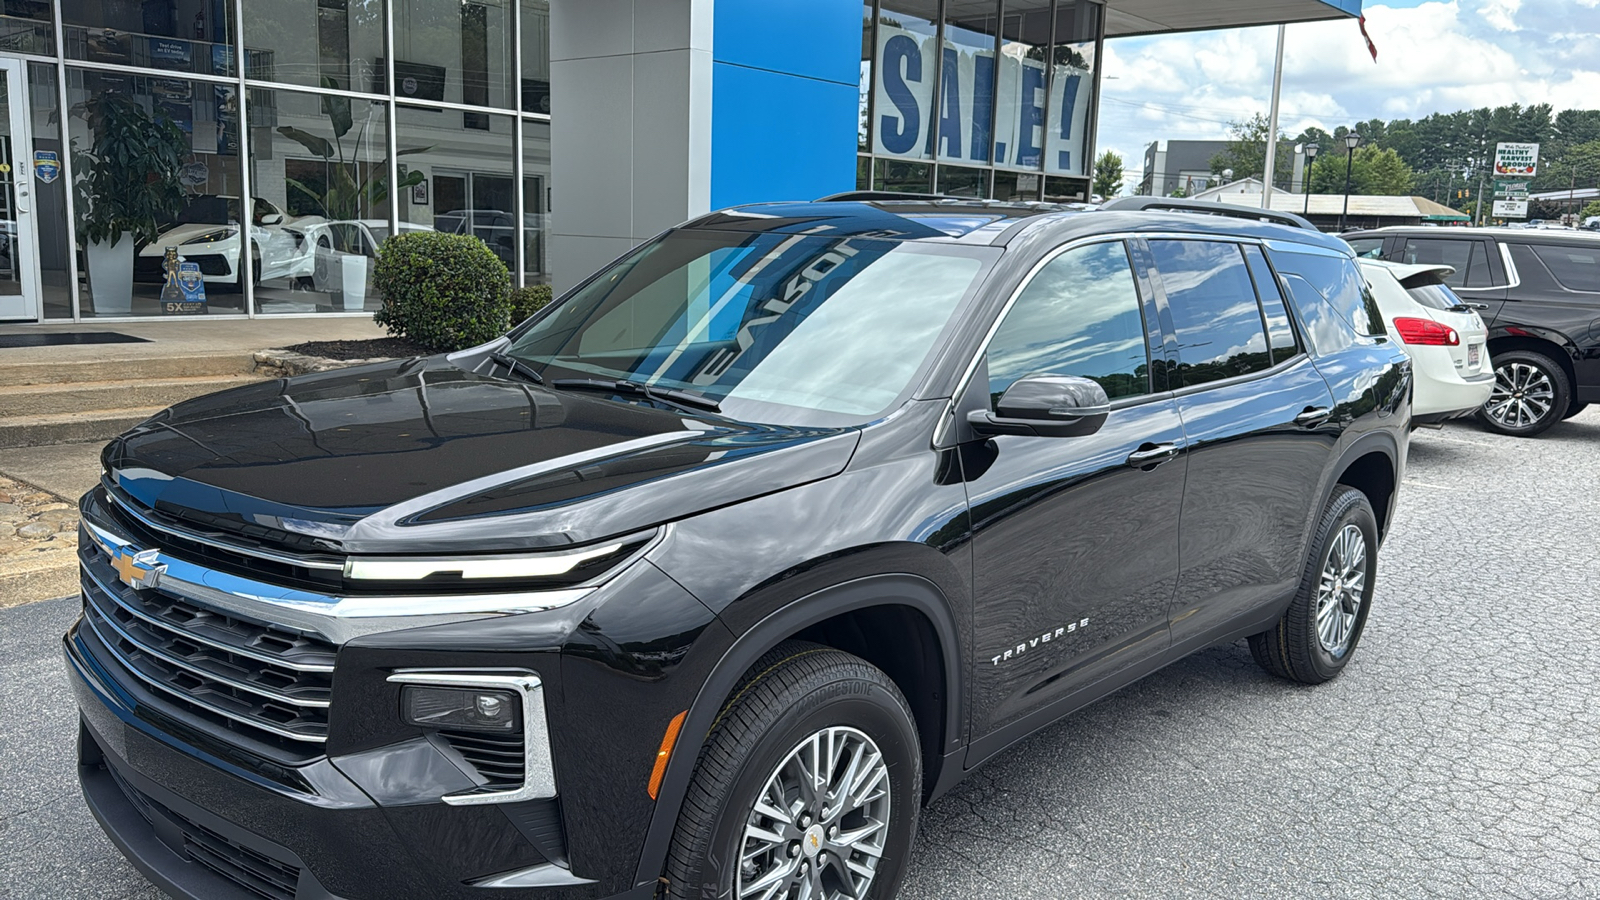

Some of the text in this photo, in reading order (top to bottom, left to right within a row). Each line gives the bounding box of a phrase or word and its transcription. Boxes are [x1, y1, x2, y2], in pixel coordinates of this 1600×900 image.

[880, 34, 1081, 171] SALE!
[167, 302, 182, 311] 5X
[991, 618, 1090, 666] TRAVERSE
[796, 681, 873, 716] BRIDGESTONE
